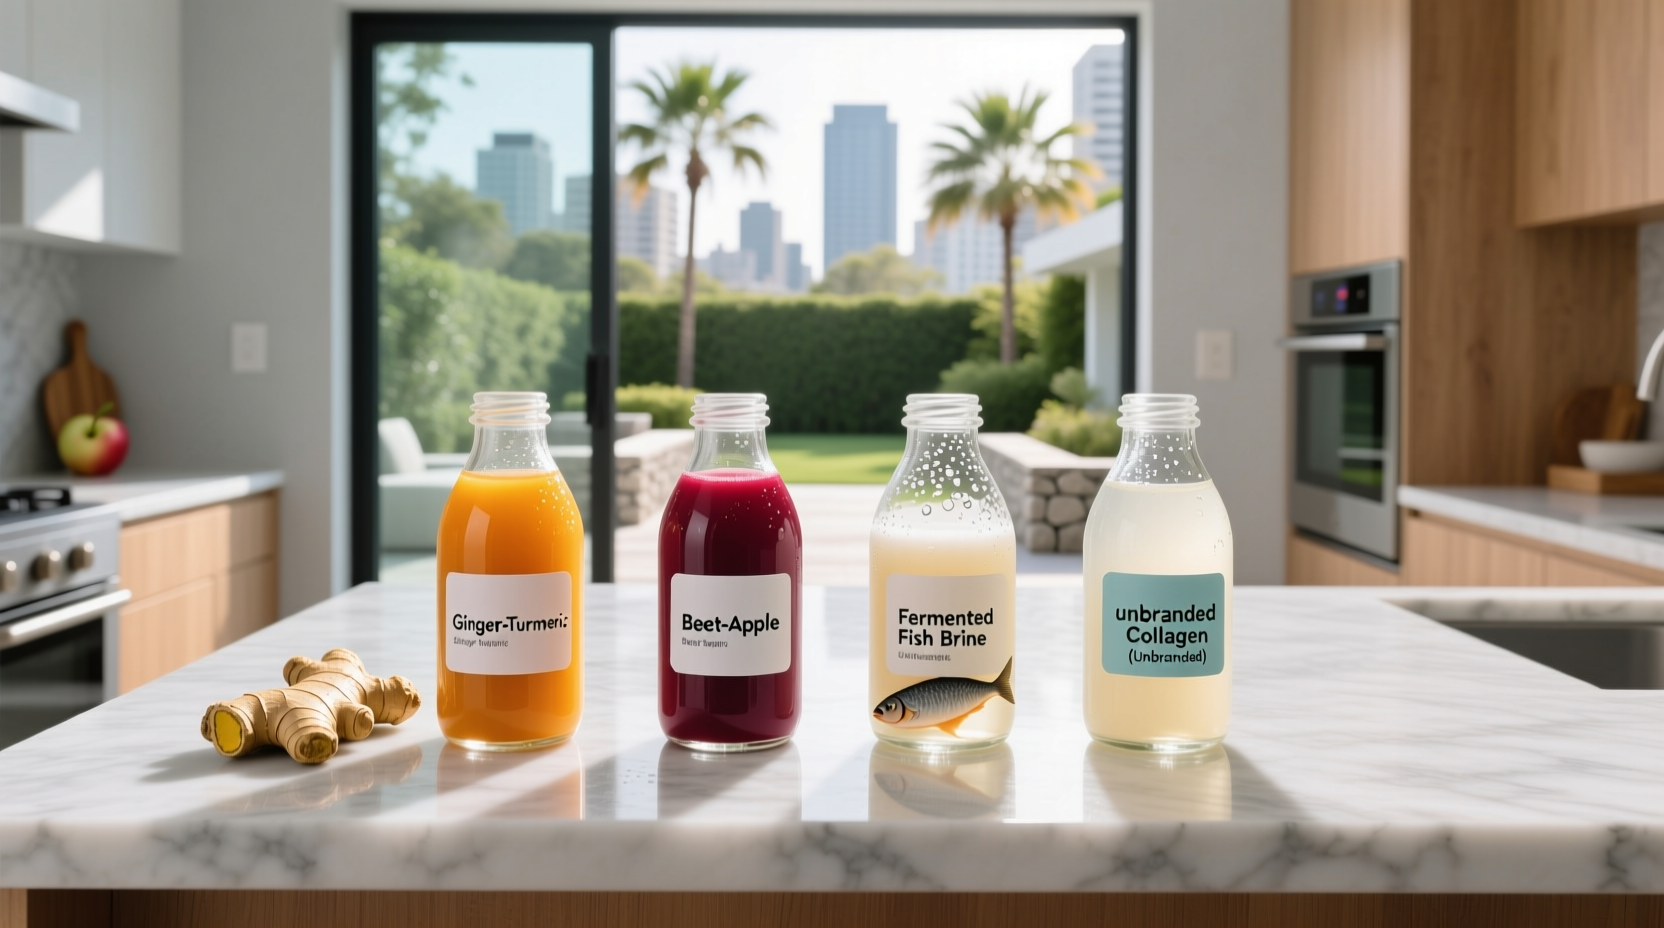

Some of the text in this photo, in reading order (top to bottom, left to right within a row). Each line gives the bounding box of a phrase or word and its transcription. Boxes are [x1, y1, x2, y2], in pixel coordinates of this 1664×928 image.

[898, 607, 994, 626] Fermented
[1115, 603, 1216, 623] unbranded
[682, 612, 780, 637] Beet-Apple
[898, 629, 987, 647] Fish Brine
[1126, 625, 1209, 648] Collagen
[1128, 648, 1207, 665] (Unbranded)
